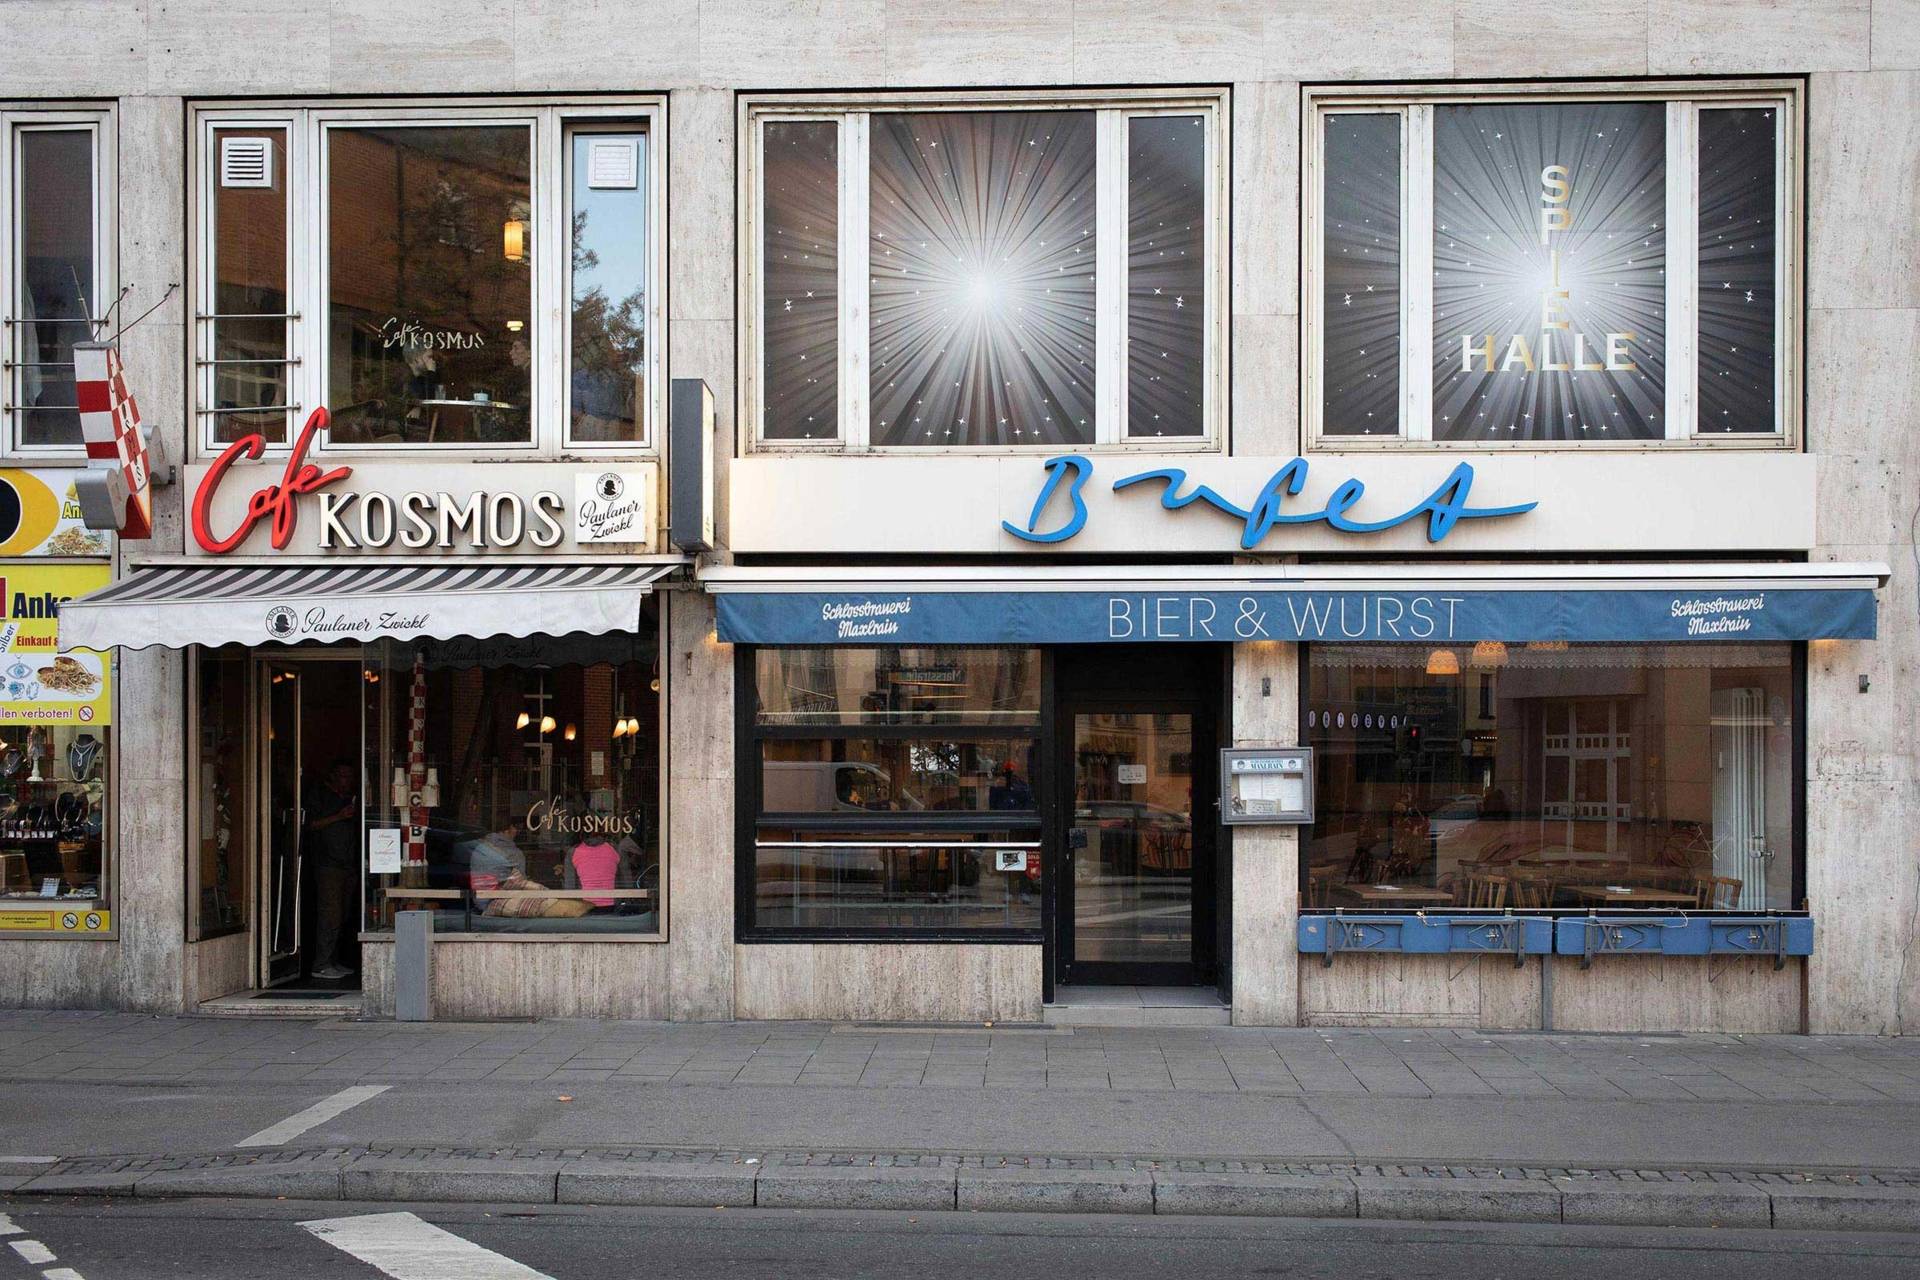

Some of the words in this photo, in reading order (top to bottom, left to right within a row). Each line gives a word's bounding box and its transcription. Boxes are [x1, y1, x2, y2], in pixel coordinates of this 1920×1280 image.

[1461, 332, 1637, 373] HALLE
[317, 490, 565, 550] KOSMOS
[578, 499, 642, 528] Paulaner
[822, 596, 912, 621] Schlossbrauerei
[1109, 597, 1216, 638] BIER
[1234, 596, 1270, 638] &
[1287, 596, 1466, 638] WURST
[1671, 593, 1765, 618] Schlossbrauerei
[301, 606, 373, 634] Paulaner
[838, 618, 899, 639] Maxlrain
[1687, 615, 1751, 636] Maxlrain
[16, 635, 52, 647] Einkauf
[21, 707, 73, 719] verboten!
[558, 815, 634, 834] KOSMOS
